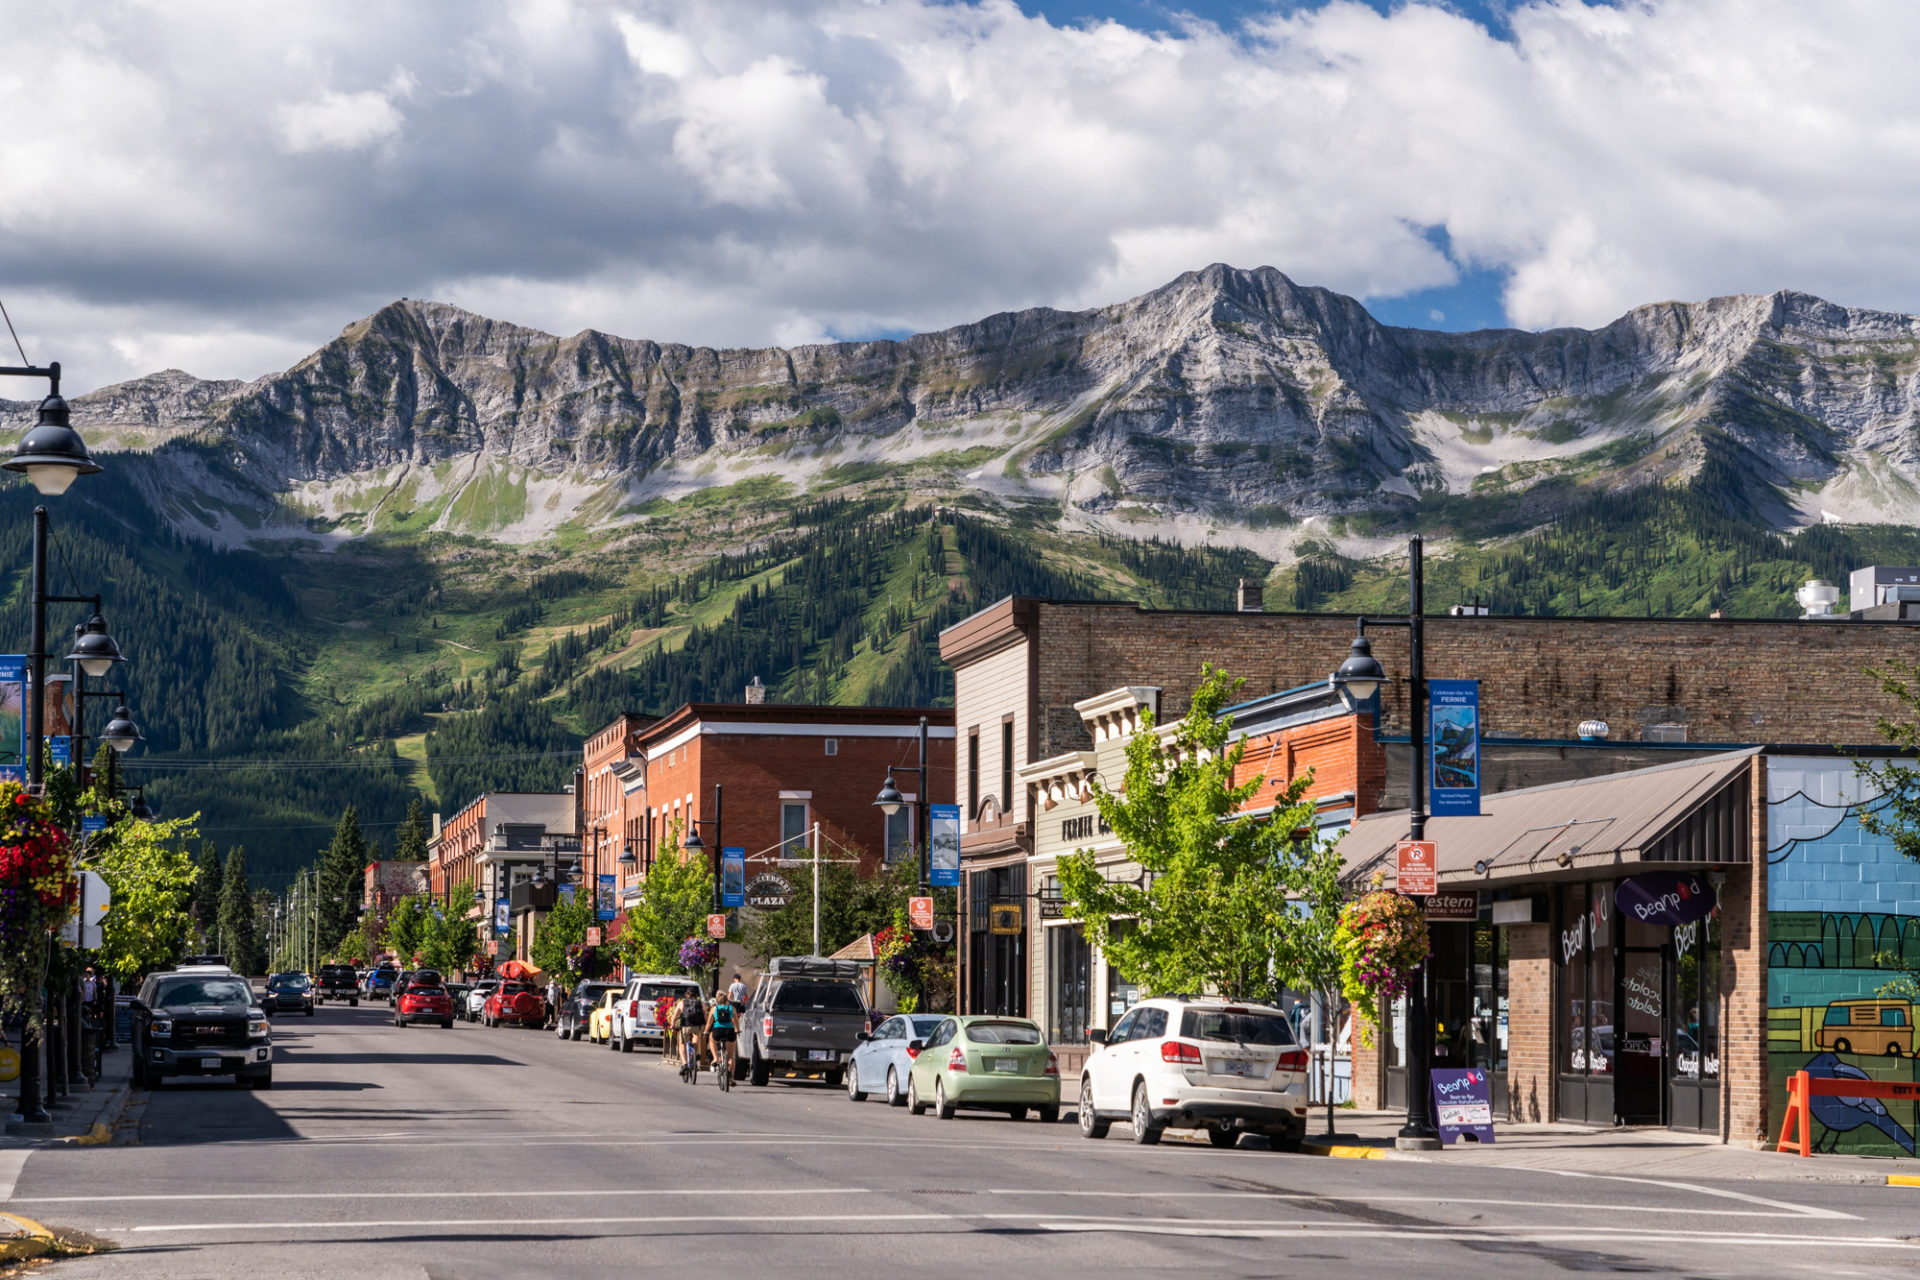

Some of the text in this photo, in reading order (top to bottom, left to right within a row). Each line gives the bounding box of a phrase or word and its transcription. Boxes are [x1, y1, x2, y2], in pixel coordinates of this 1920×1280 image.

[1061, 814, 1094, 842] FERNIE
[744, 875, 793, 893] HUCKLEBERRY
[750, 896, 786, 906] PLAZA
[1634, 878, 1701, 920] Beanpod
[1625, 1041, 1649, 1050] OPEN
[1437, 1070, 1484, 1095] Beanpod
